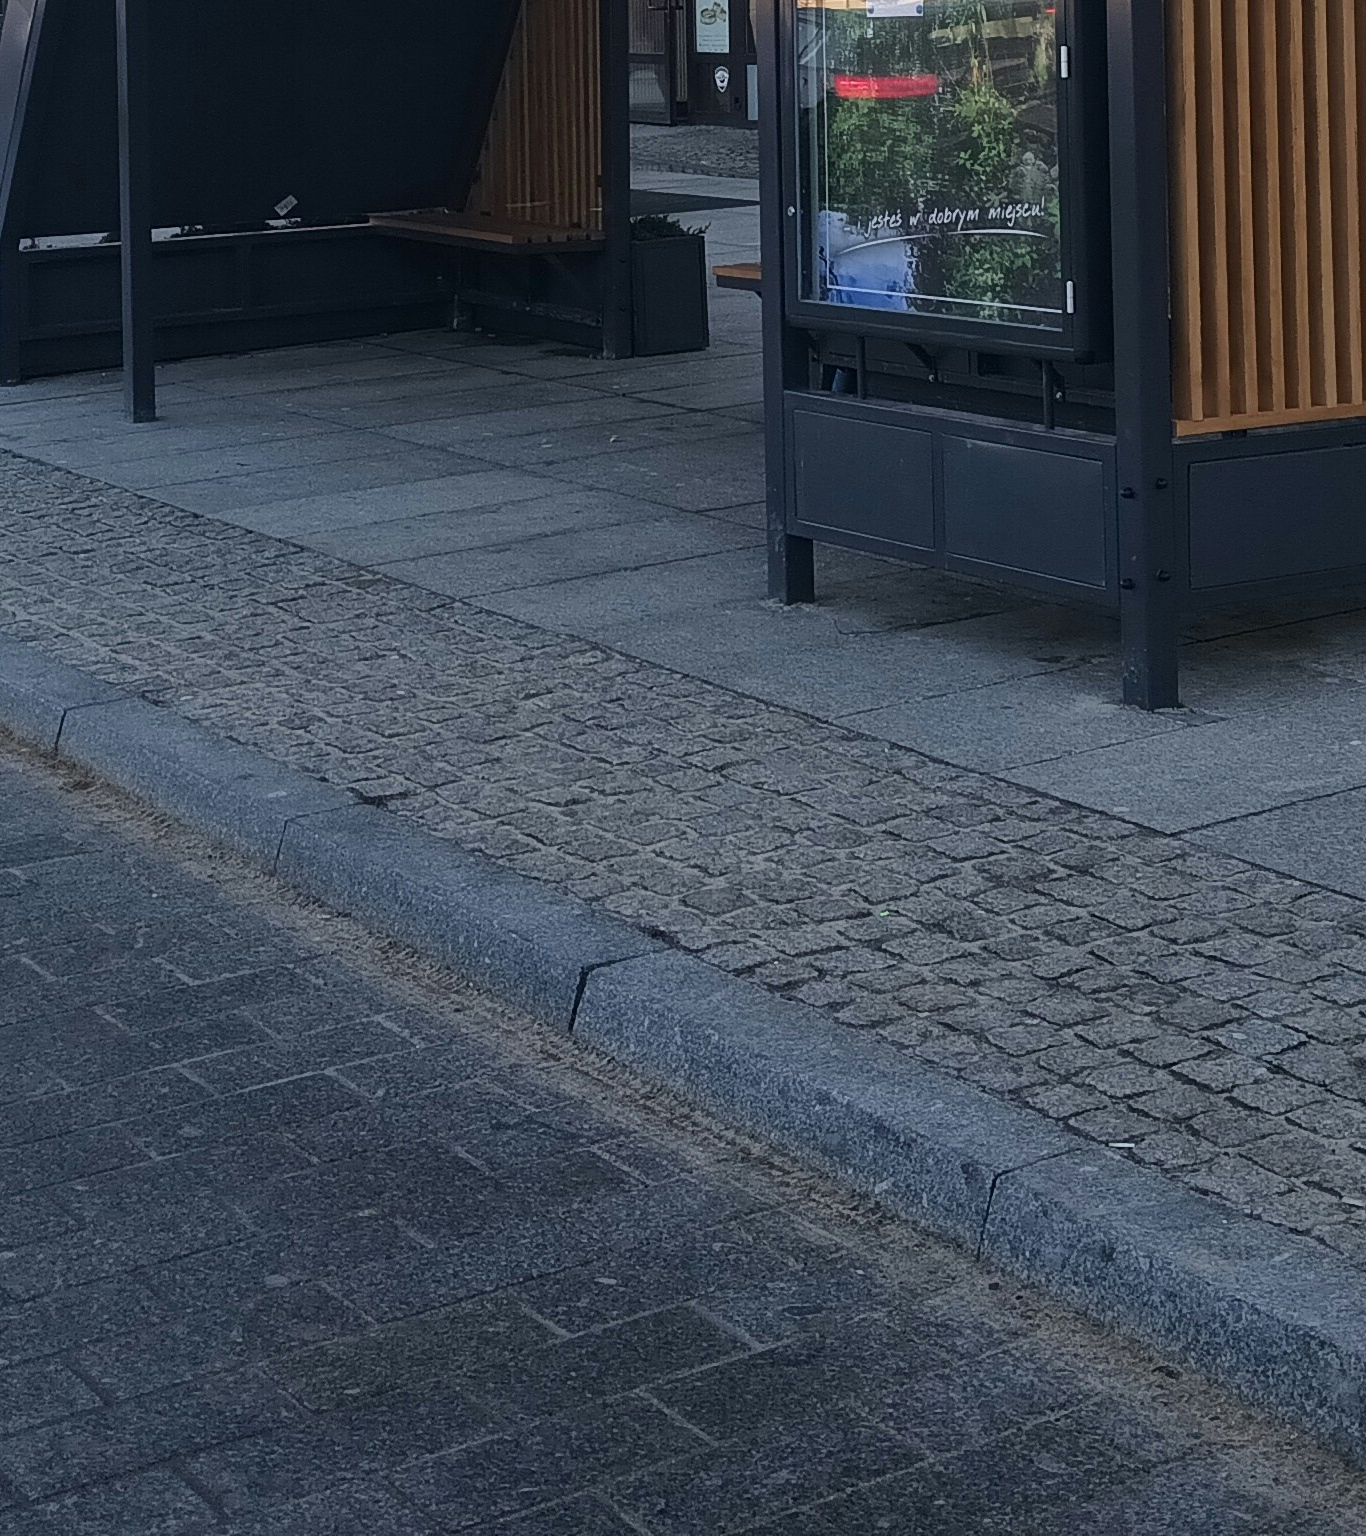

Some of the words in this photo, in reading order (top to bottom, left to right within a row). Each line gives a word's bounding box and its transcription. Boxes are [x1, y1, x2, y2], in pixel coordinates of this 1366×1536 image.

[865, 210, 902, 238] jesteś
[909, 215, 920, 226] w
[928, 207, 979, 232] dobrym
[988, 195, 1045, 227] miejscu!
